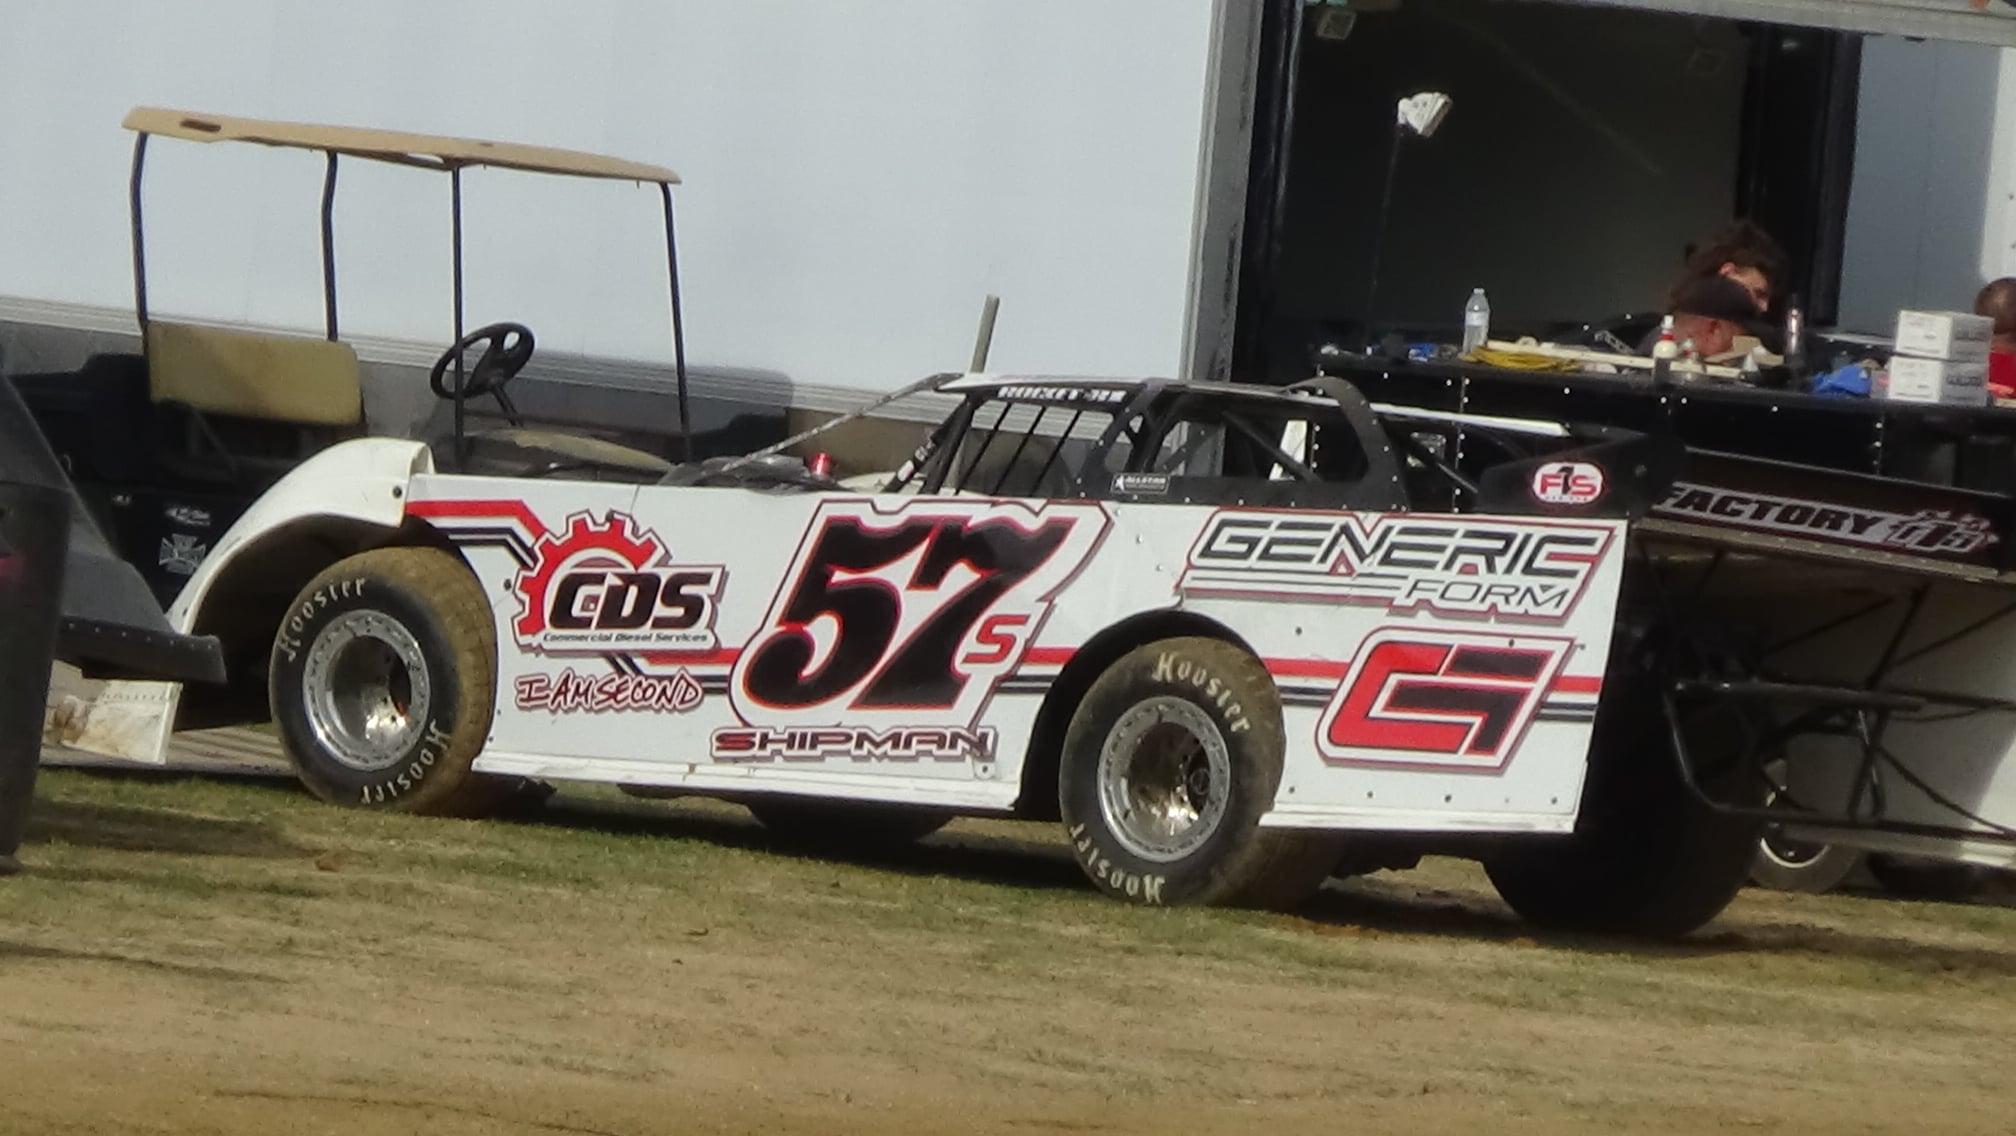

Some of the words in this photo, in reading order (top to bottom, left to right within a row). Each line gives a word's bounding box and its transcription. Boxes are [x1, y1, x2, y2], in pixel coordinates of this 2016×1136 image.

[1199, 519, 1600, 577] GENERIC
[1405, 578, 1571, 609] FORM
[543, 632, 614, 642] Commercial
[615, 633, 652, 642] Diesel
[655, 633, 708, 643] Services
[1152, 652, 1250, 734] Hoosier
[714, 731, 992, 756] SHIPMAN
